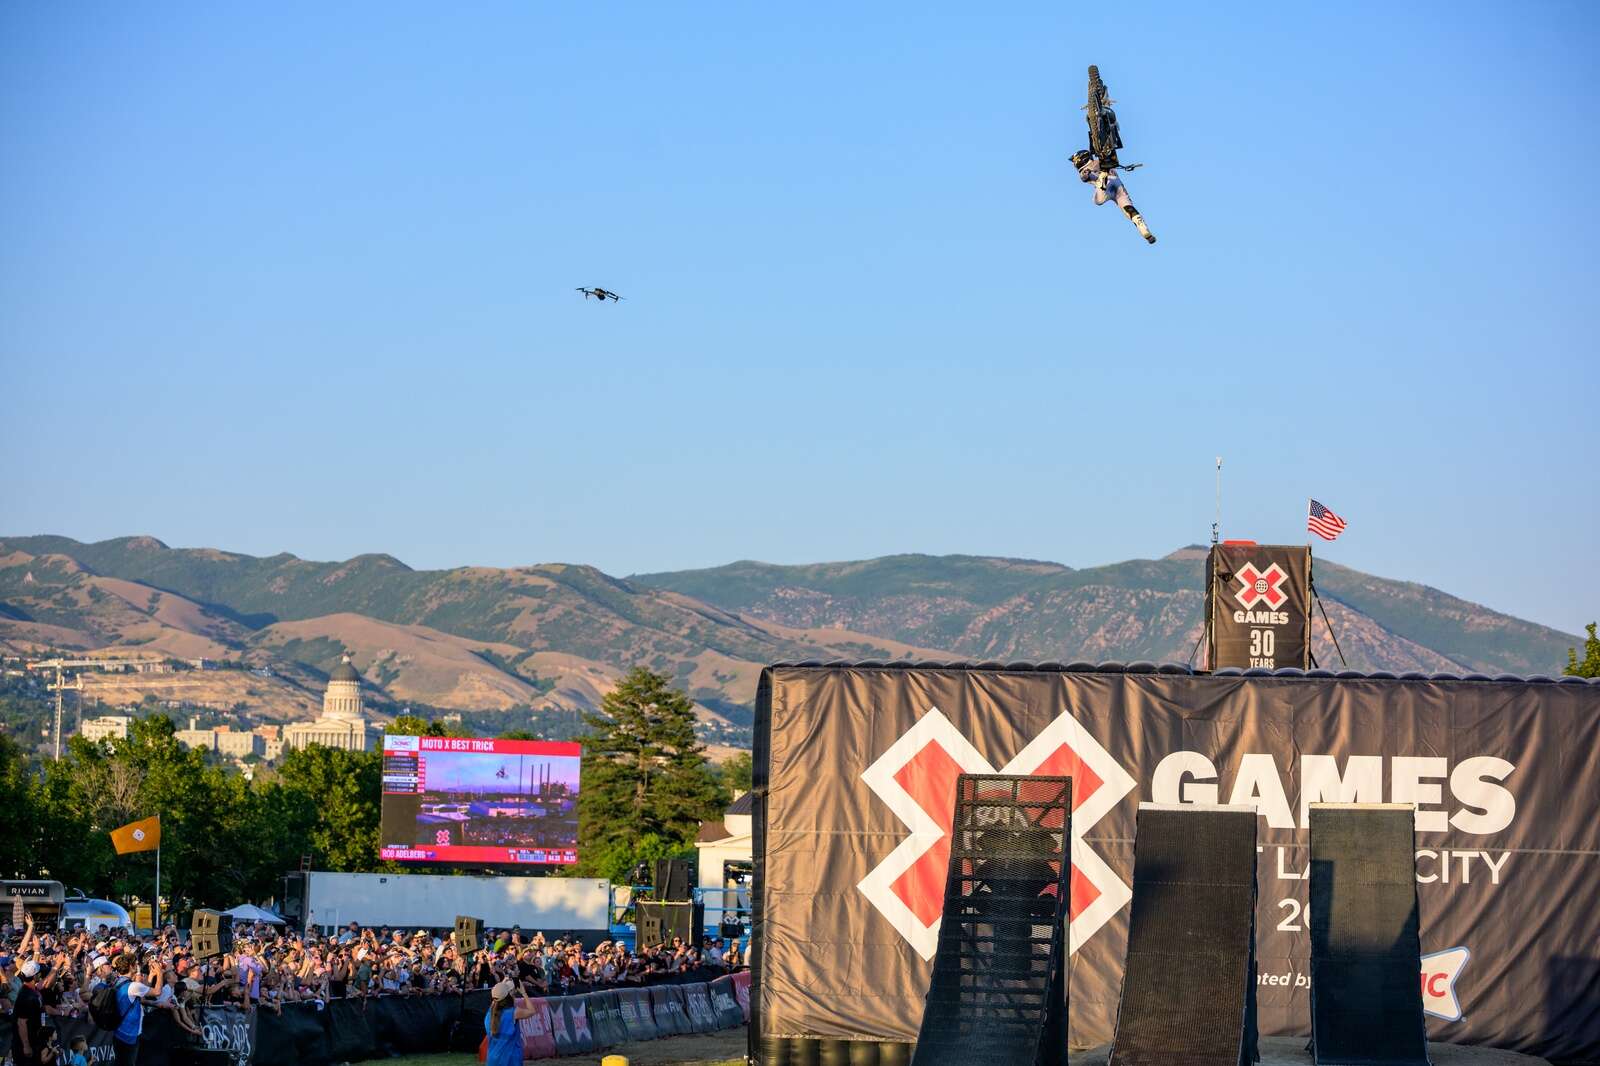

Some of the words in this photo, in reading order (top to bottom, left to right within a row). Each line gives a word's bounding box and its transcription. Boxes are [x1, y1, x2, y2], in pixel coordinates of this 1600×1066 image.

[1233, 610, 1289, 625] GAMES
[1249, 629, 1275, 657] 30
[1249, 658, 1275, 669] YEARS
[421, 738, 443, 749] MOTO
[444, 739, 450, 750] X
[451, 739, 469, 750] BEST
[472, 740, 494, 752] TRICK
[1151, 750, 1516, 835] GAMES
[1415, 849, 1512, 885] CITY
[11, 887, 45, 895] RIVIAN
